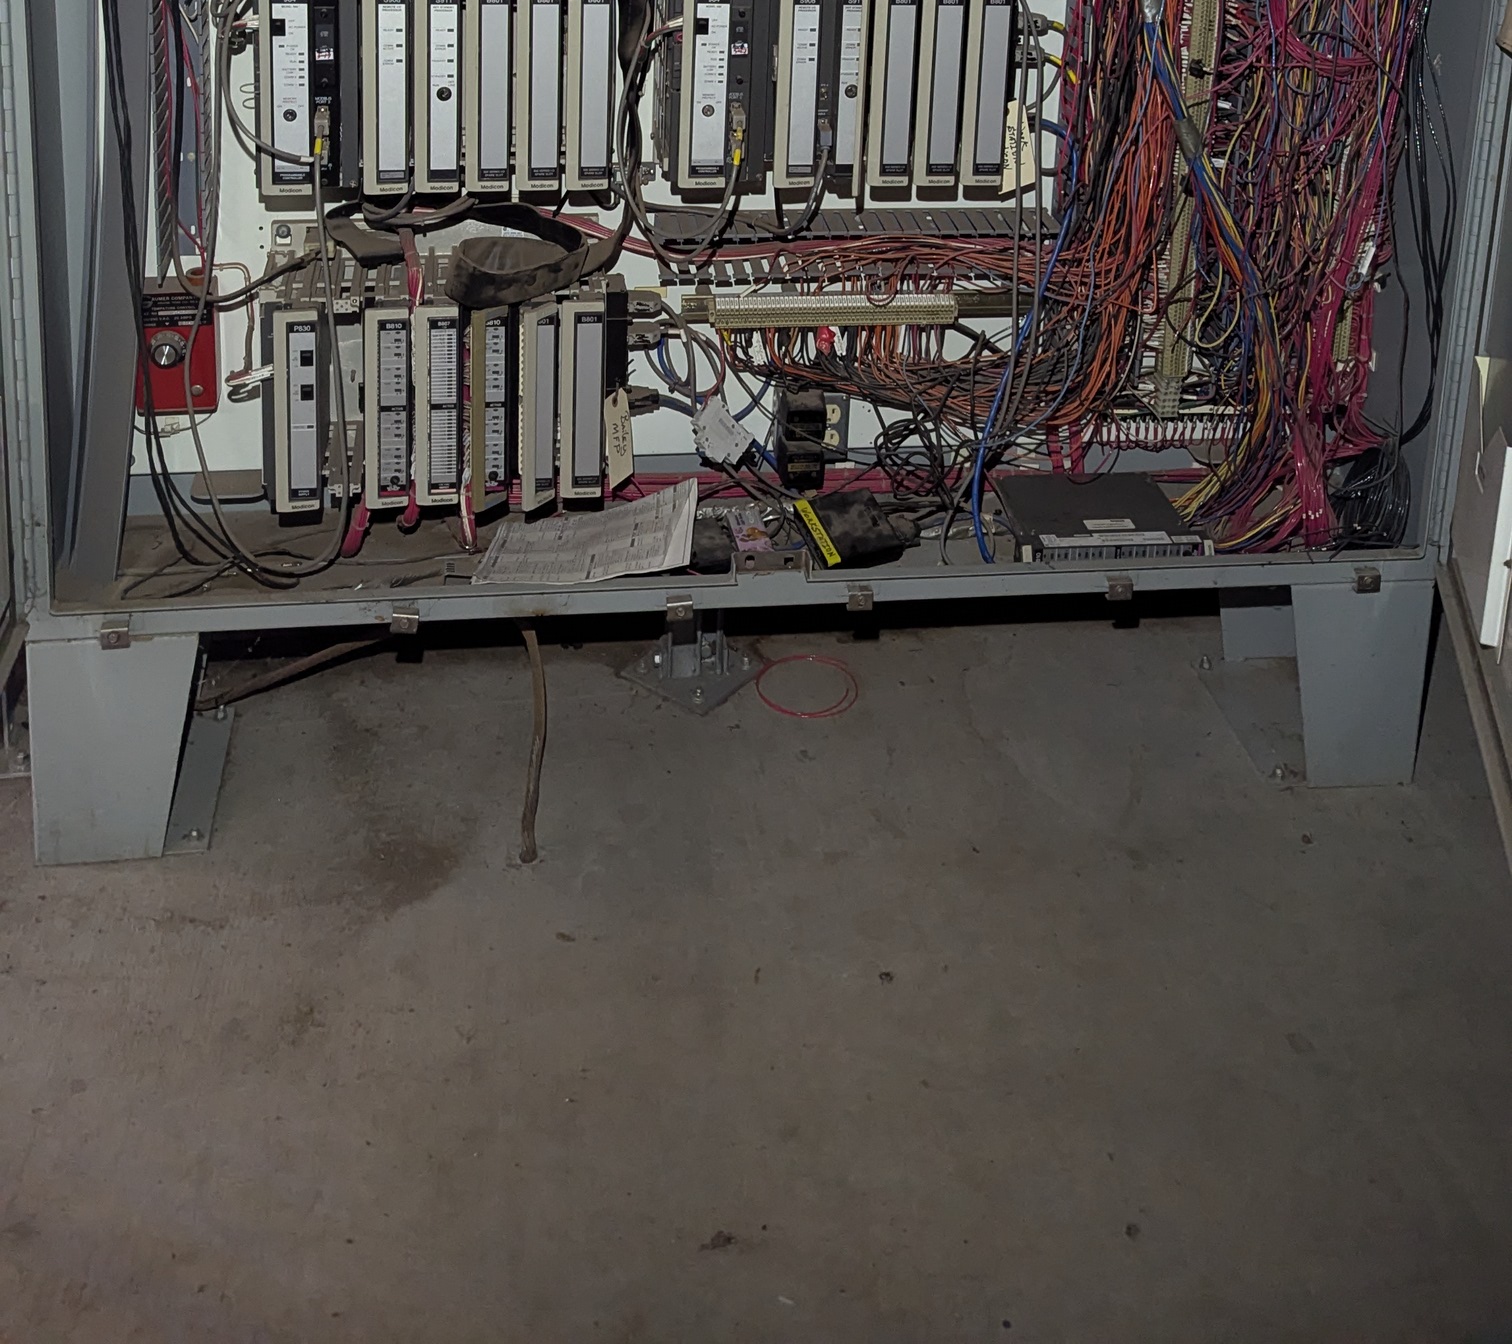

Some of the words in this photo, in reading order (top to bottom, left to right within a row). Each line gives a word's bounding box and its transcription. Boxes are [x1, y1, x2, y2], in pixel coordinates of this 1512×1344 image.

[612, 423, 620, 454] MFP
[620, 410, 630, 457] Bailey
[802, 507, 836, 558] WORKSTATION
